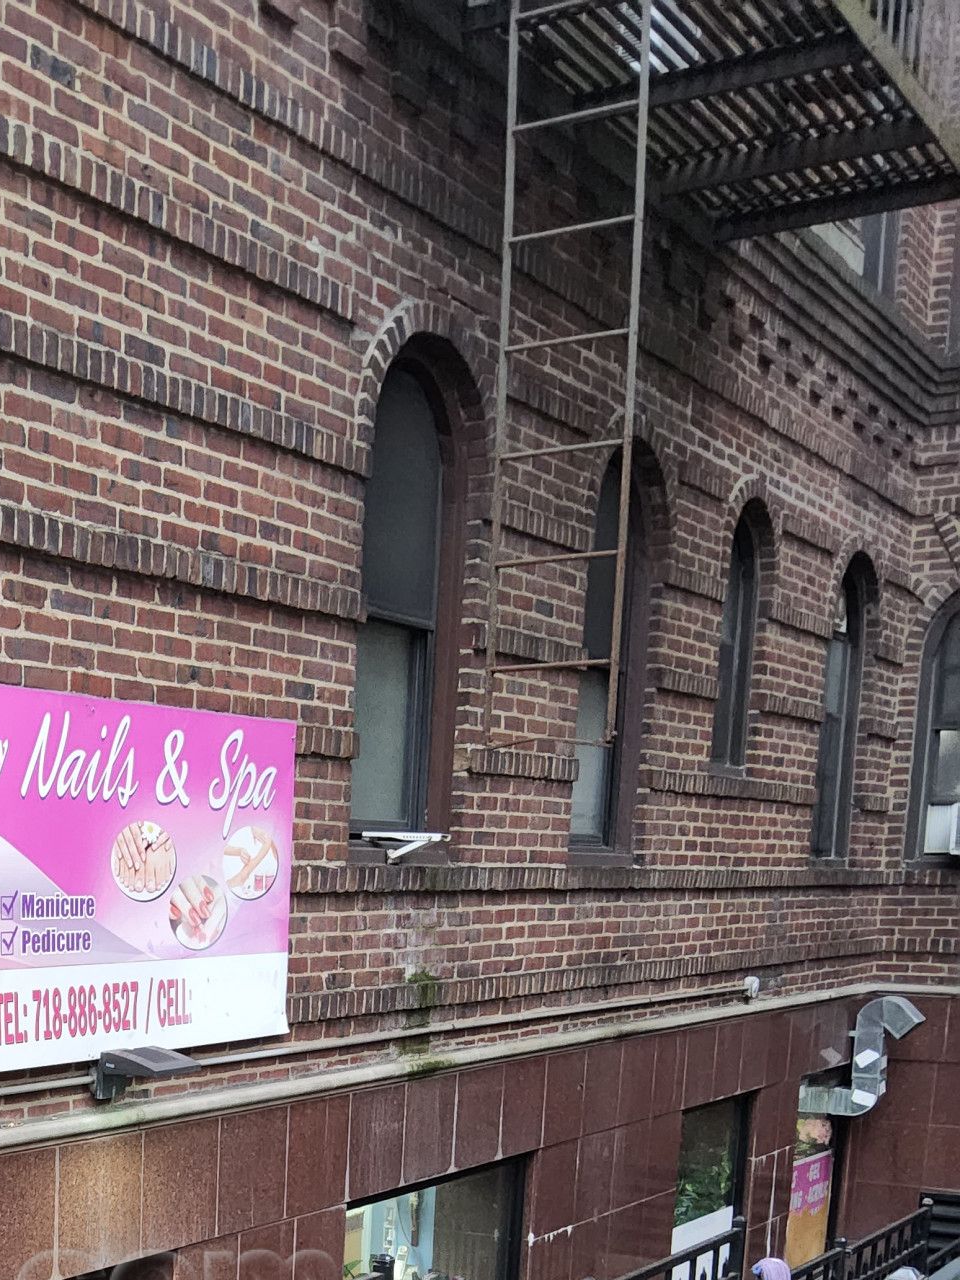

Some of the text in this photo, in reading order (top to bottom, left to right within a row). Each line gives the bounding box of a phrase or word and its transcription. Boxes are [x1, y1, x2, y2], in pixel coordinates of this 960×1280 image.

[20, 711, 139, 807] Nails
[155, 729, 190, 807] &
[208, 729, 278, 840] Spa
[21, 894, 95, 919] Manicure
[21, 929, 91, 954] Pedicure
[32, 981, 139, 1041] 718-886-8527
[145, 977, 154, 1034] /
